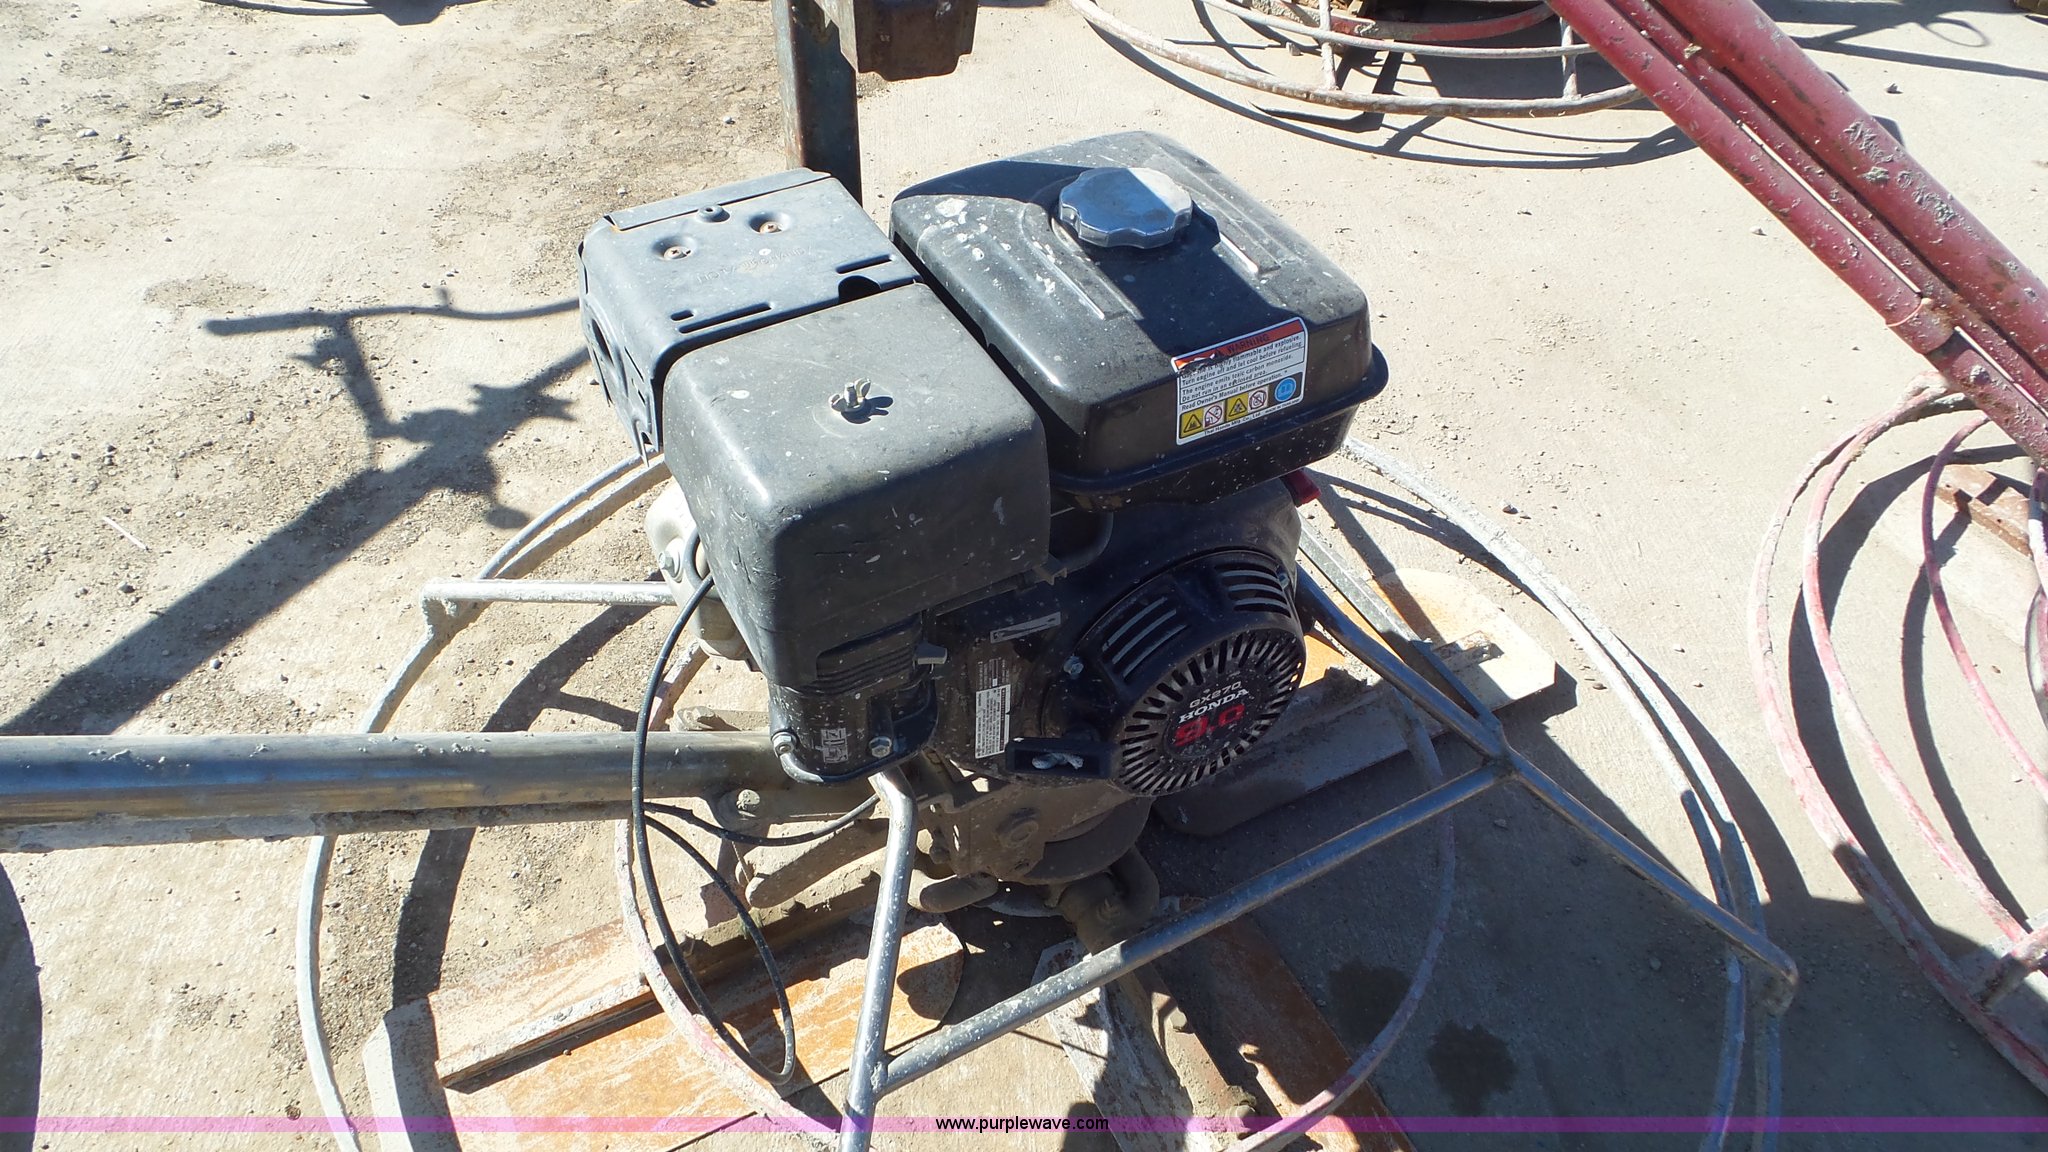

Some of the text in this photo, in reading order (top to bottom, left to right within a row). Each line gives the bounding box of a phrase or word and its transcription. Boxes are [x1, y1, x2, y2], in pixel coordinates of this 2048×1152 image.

[1228, 334, 1270, 354] WARNING
[1233, 348, 1262, 362] flammable
[1264, 344, 1274, 352] and
[1275, 335, 1301, 348] explosive.
[1182, 377, 1195, 386] Turn
[1196, 371, 1215, 383] engine
[1226, 363, 1236, 371] and
[1246, 356, 1258, 364] cool
[1260, 350, 1276, 360] before
[1182, 387, 1193, 396] The
[1194, 381, 1213, 393] engine
[1215, 375, 1230, 384] emits
[1232, 370, 1244, 379] toxic
[1246, 363, 1264, 374] carbon
[1182, 372, 1282, 411] Read Owner's Manual before operation.
[1178, 689, 1249, 724] HONDA
[1189, 681, 1242, 709] GX270
[1173, 703, 1246, 747] 9.0
